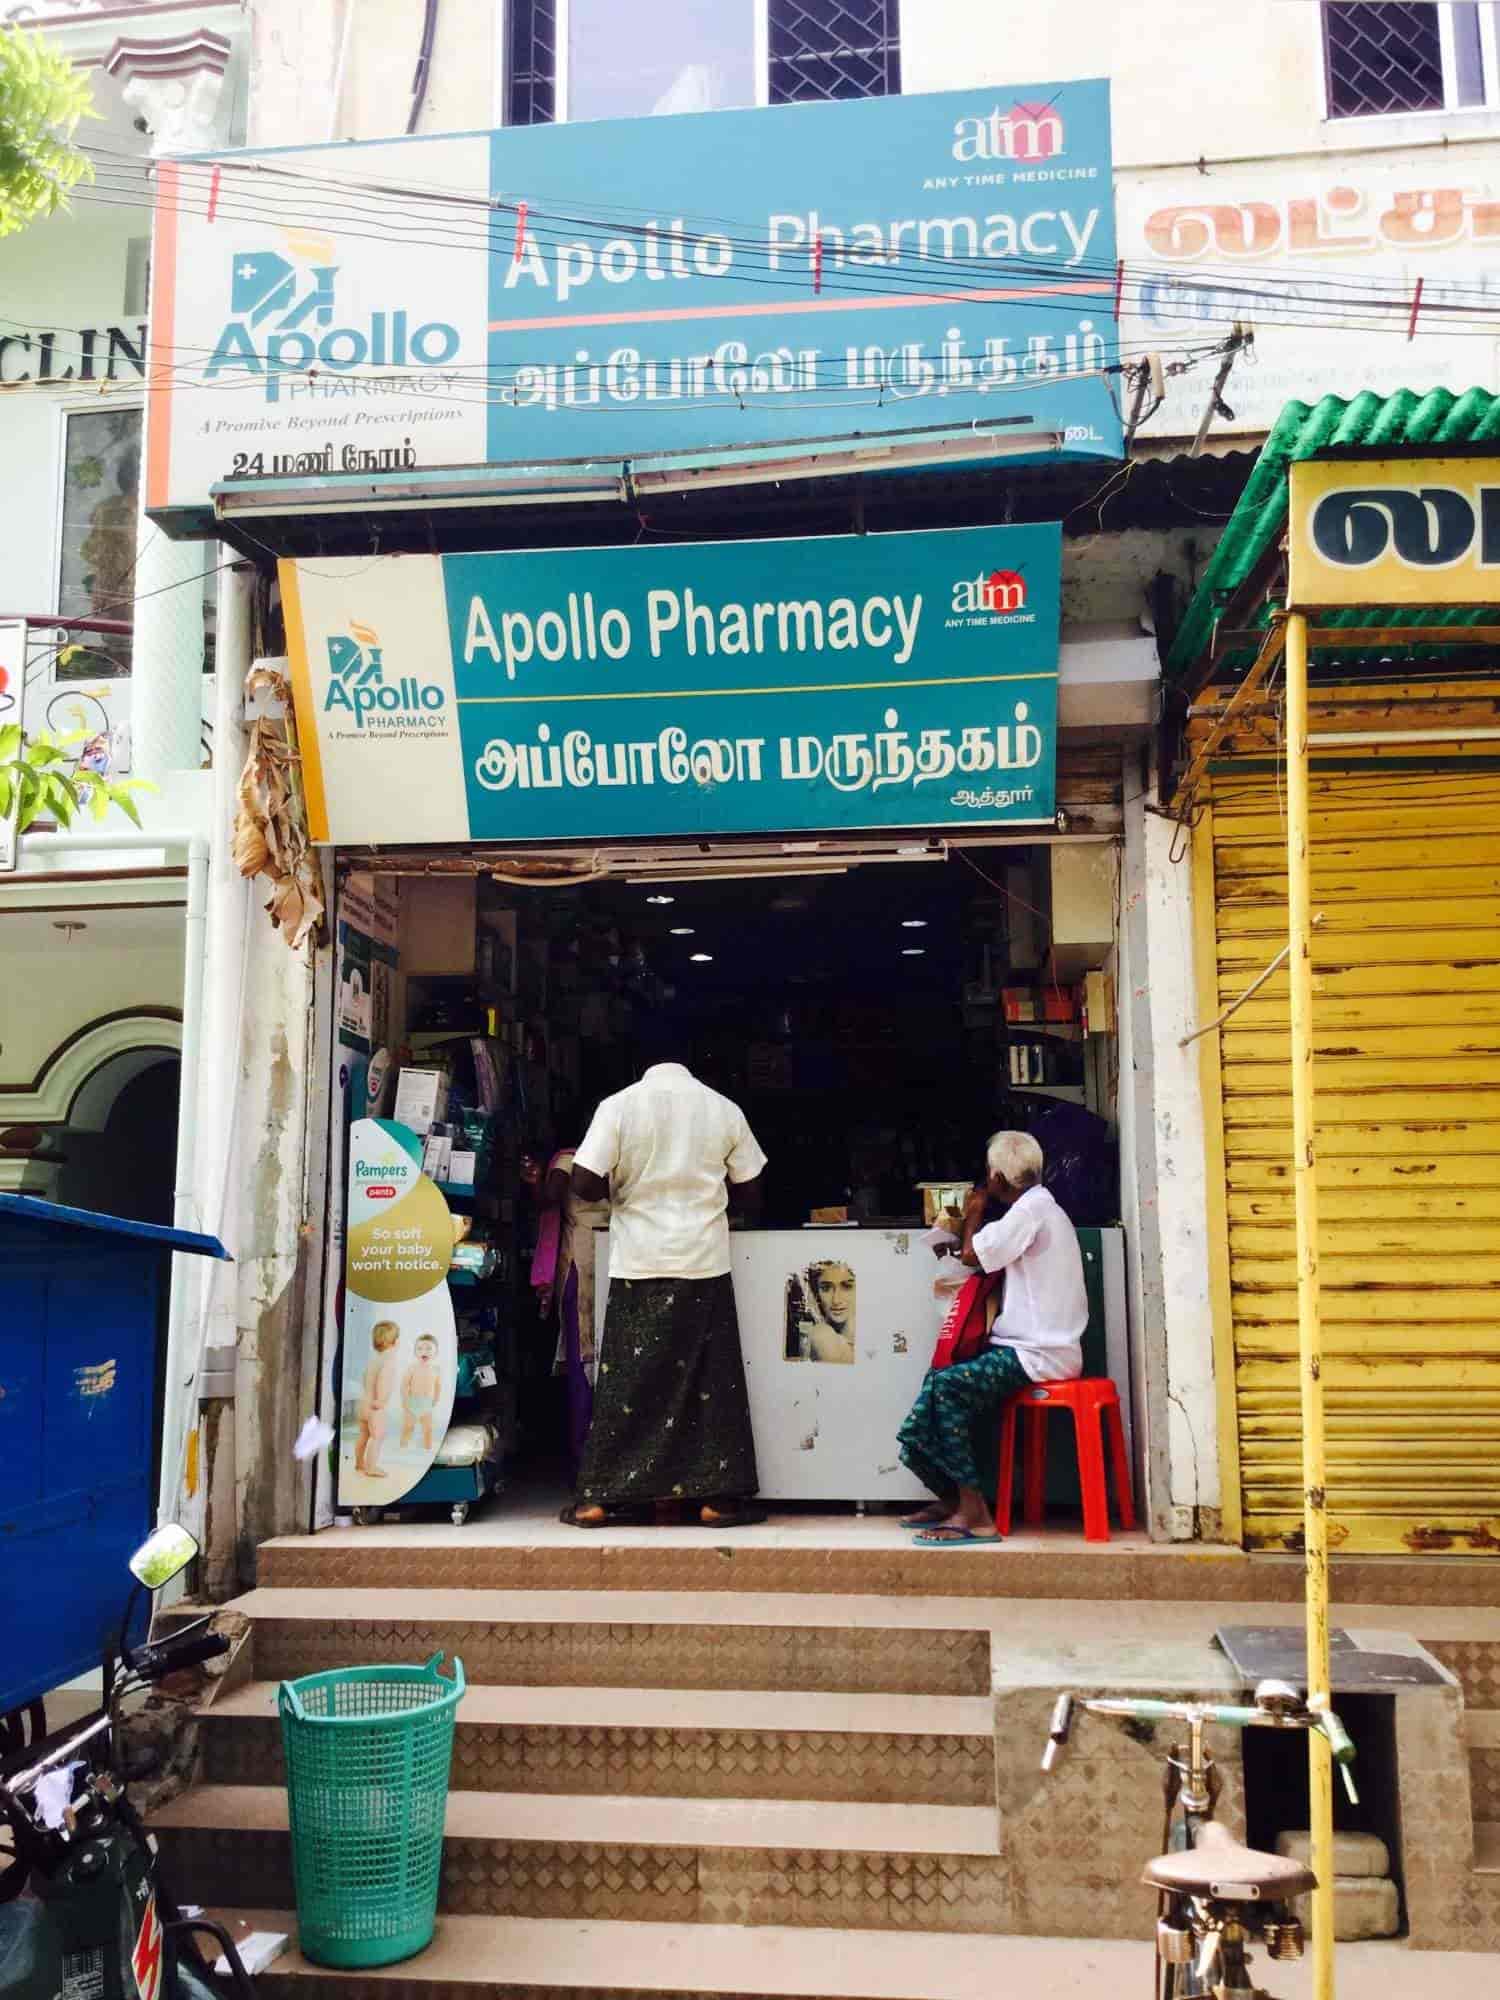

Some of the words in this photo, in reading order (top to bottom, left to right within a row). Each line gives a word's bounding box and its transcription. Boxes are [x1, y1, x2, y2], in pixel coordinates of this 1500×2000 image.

[952, 104, 1067, 161] atm
[923, 176, 960, 190] ANY
[964, 173, 1007, 185] TIME
[1012, 167, 1098, 183] MEDICINE
[503, 218, 733, 303] Apollo
[768, 208, 1100, 272] Pharmacy
[202, 310, 461, 403] Apollo
[502, 341, 821, 411] அப்போலோ
[845, 319, 1105, 399] மருந்தகம்
[289, 371, 463, 400] PHARMACY
[215, 418, 281, 433] Promise
[287, 411, 348, 431] Beyond
[354, 406, 463, 426] Prescriptions
[232, 452, 264, 476] 24
[273, 442, 335, 474] மணி
[951, 570, 1027, 614] atm
[464, 591, 631, 680] Apollo
[648, 587, 922, 664] Pharmacy
[944, 619, 964, 629] ANY
[967, 617, 989, 627] TIME
[990, 614, 1036, 625] MEDICINE
[324, 678, 445, 728] Apollo
[367, 715, 446, 728] PHARMACY
[475, 723, 765, 791] அப்போலோ
[779, 702, 1042, 793] மருந்தகம்
[355, 1160, 408, 1178] Pampers
[368, 1189, 394, 1197] pants
[373, 1228, 390, 1240] So
[394, 1227, 423, 1240] soft
[352, 1260, 392, 1271] won't
[396, 1258, 443, 1270] notice.
[361, 1247, 393, 1258] your
[398, 1243, 433, 1256] baby
